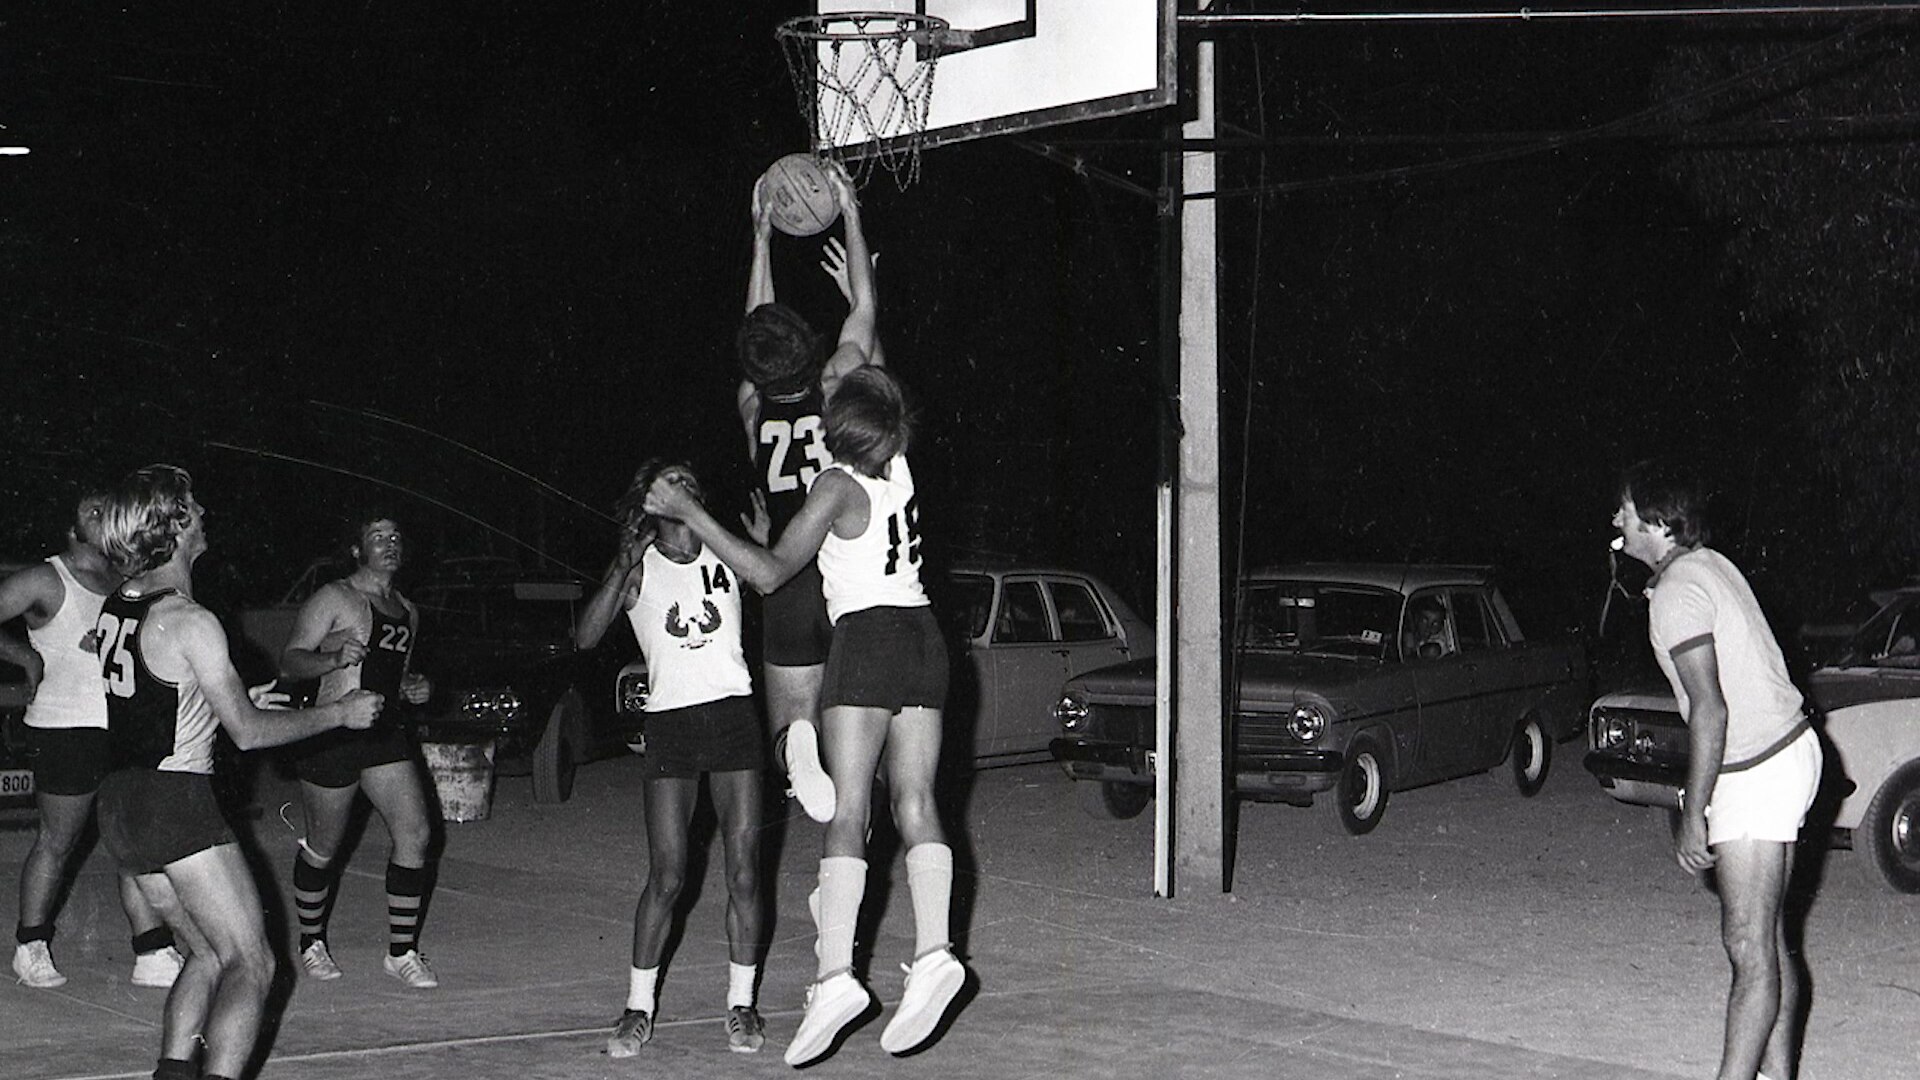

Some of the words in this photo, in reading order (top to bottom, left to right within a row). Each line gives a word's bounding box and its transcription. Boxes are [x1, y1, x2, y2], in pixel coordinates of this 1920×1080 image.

[760, 415, 834, 493] 23
[700, 563, 730, 595] 14
[379, 623, 410, 653] 22
[97, 612, 138, 699] 25
[3, 775, 30, 792] 800
